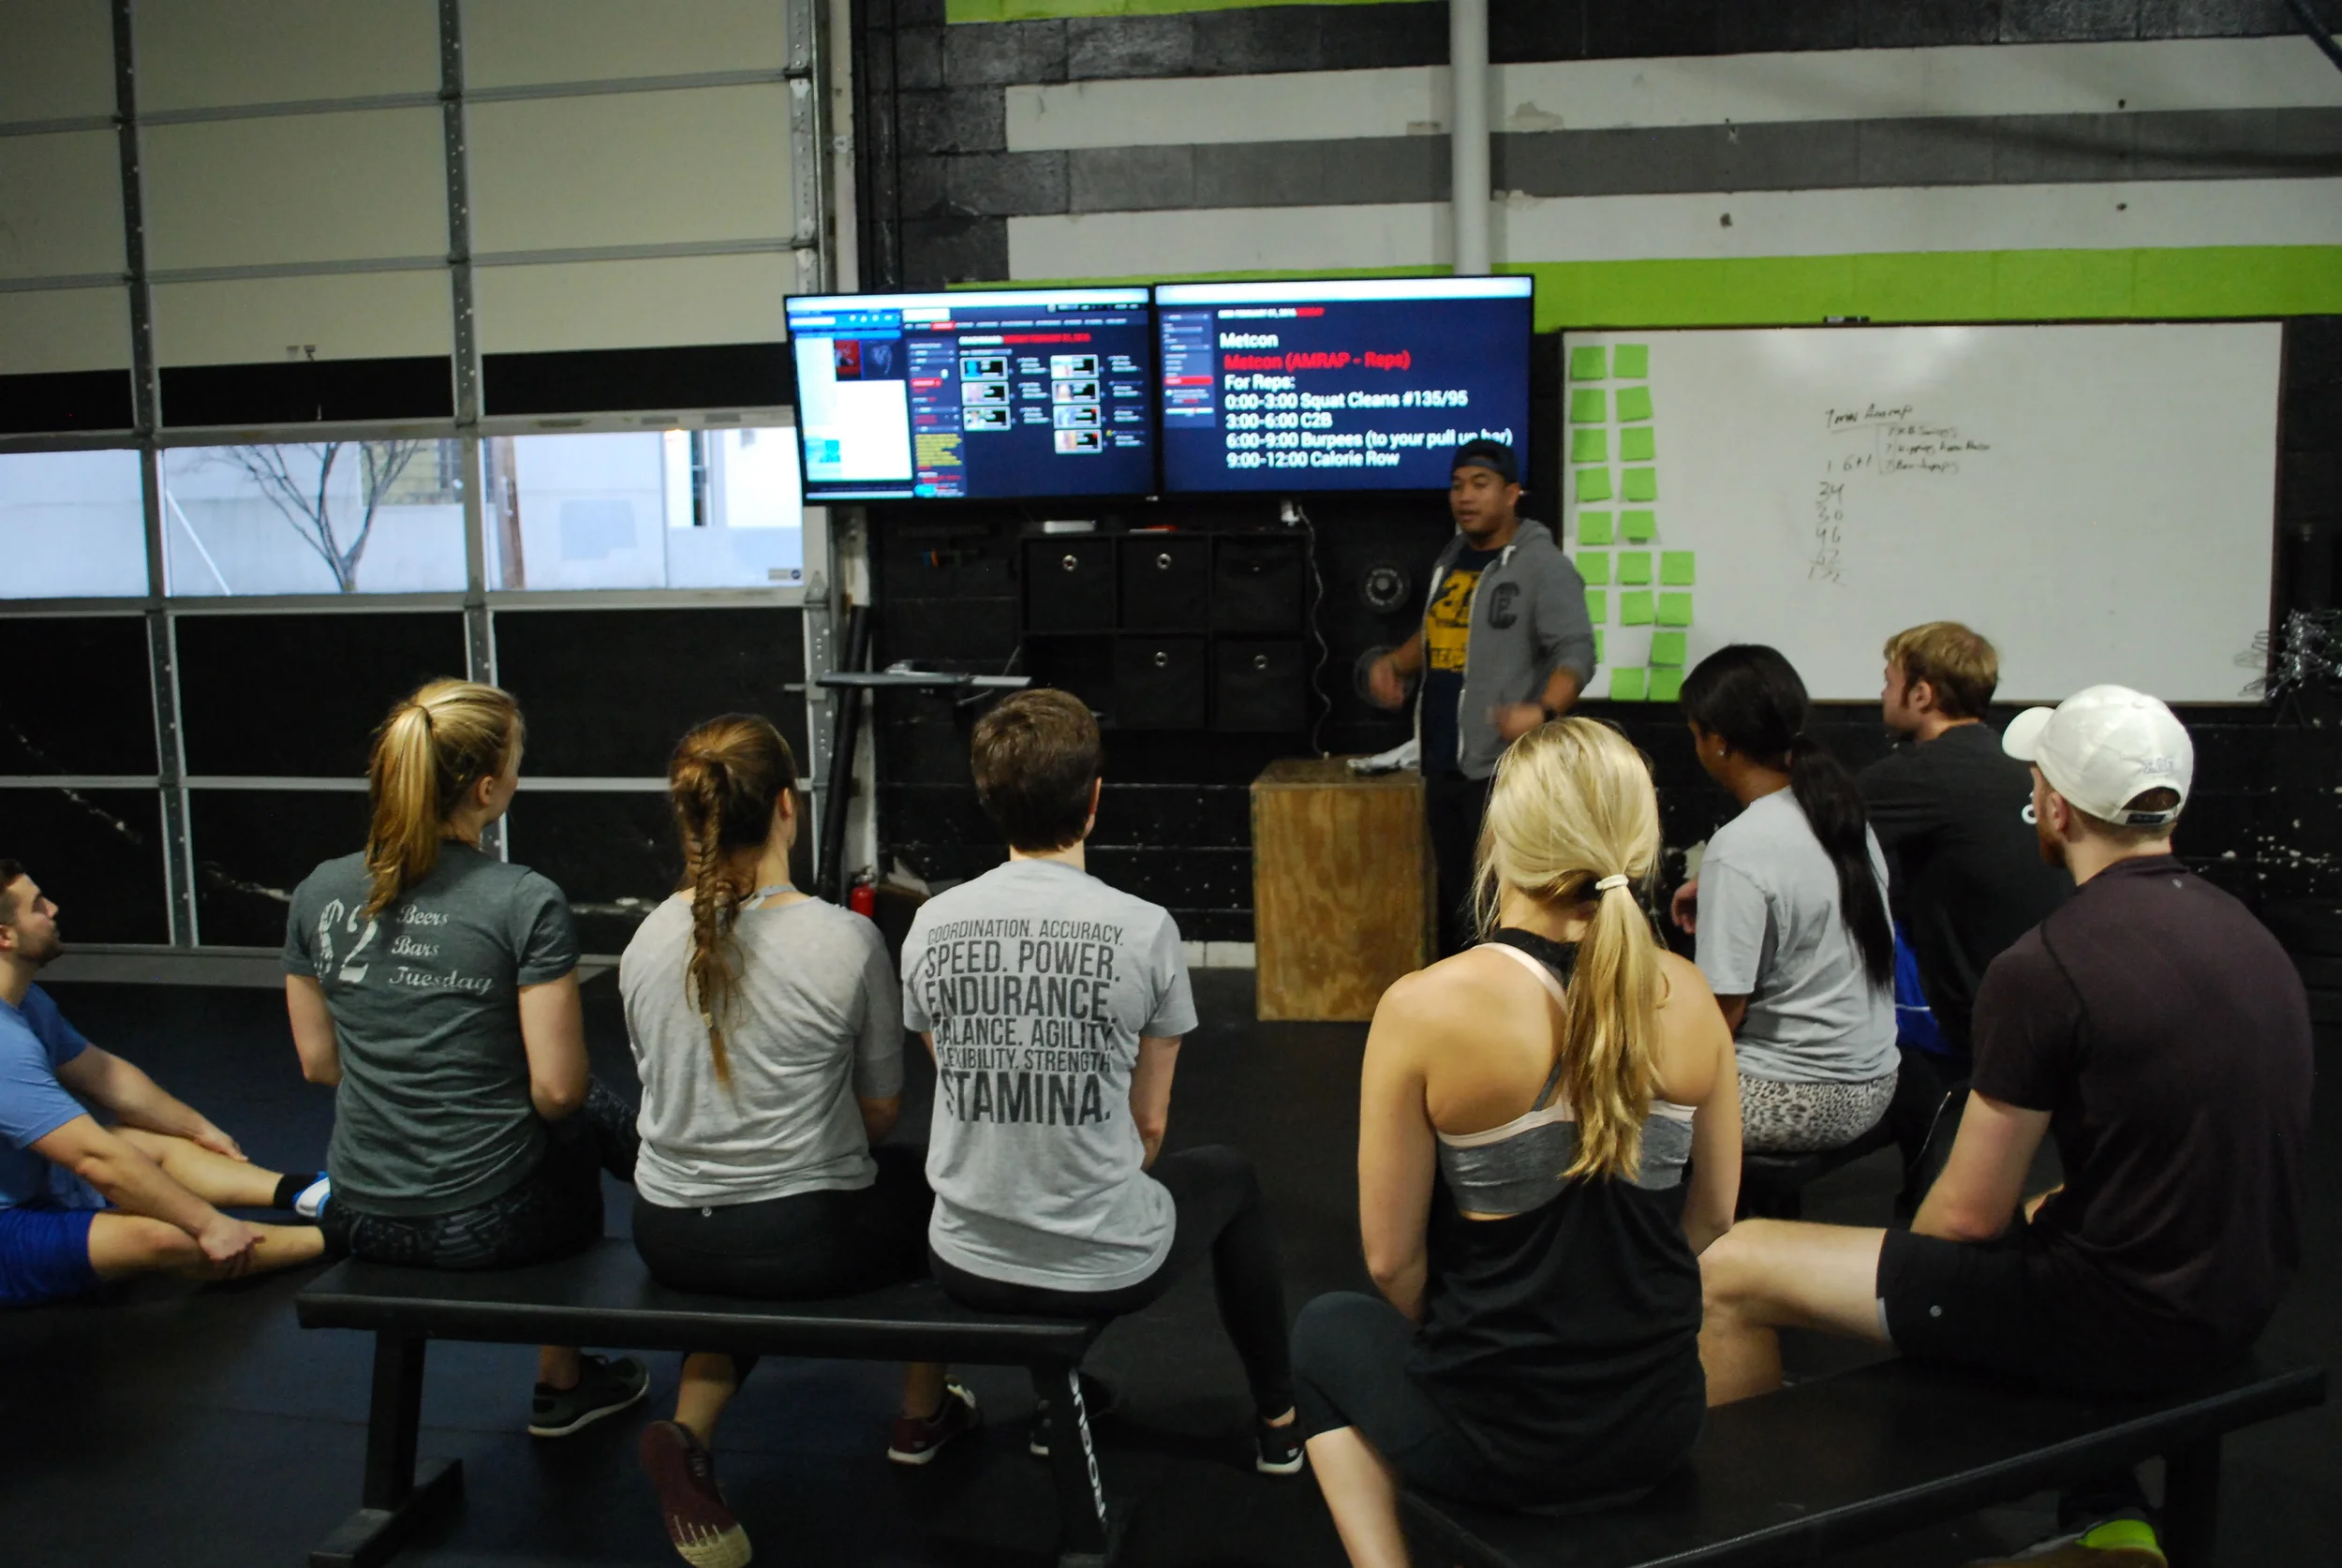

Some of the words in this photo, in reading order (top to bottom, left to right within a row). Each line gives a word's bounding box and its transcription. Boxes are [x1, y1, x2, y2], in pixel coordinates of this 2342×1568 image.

[1219, 333, 1279, 349] Metcon
[1223, 354, 1282, 370] Metcon
[1284, 351, 1351, 372] (AMRAP
[1364, 349, 1411, 371] Reps)
[1224, 374, 1251, 391] For
[1252, 374, 1297, 392] Reps:
[1224, 392, 1298, 410] 0:00-3:00
[1299, 392, 1346, 411] Squat
[1347, 391, 1400, 409] Cleans
[1401, 389, 1469, 407] #135/95
[1225, 412, 1299, 430] 3:00-6:00
[1300, 411, 1333, 429] C2B
[1225, 431, 1299, 450] 6:00-9:00
[1300, 431, 1364, 451] Burpees
[1365, 428, 1388, 450] (to
[1389, 432, 1425, 451] your
[1426, 428, 1457, 450] pull
[1226, 451, 1309, 468] 9:00-12:00
[1310, 450, 1364, 468] Calorie
[1365, 450, 1401, 467] Row
[399, 904, 451, 926] Beers
[927, 919, 1033, 945] COORDINATION.
[1039, 920, 1123, 946] ACCURACY.
[392, 935, 440, 956] Bars
[925, 939, 1008, 979] SPEED.
[1018, 939, 1120, 983] POWER.
[389, 966, 494, 996] Tuesday
[926, 975, 1118, 1024] ENDURANCE.
[1030, 1019, 1115, 1050] AGILITY.
